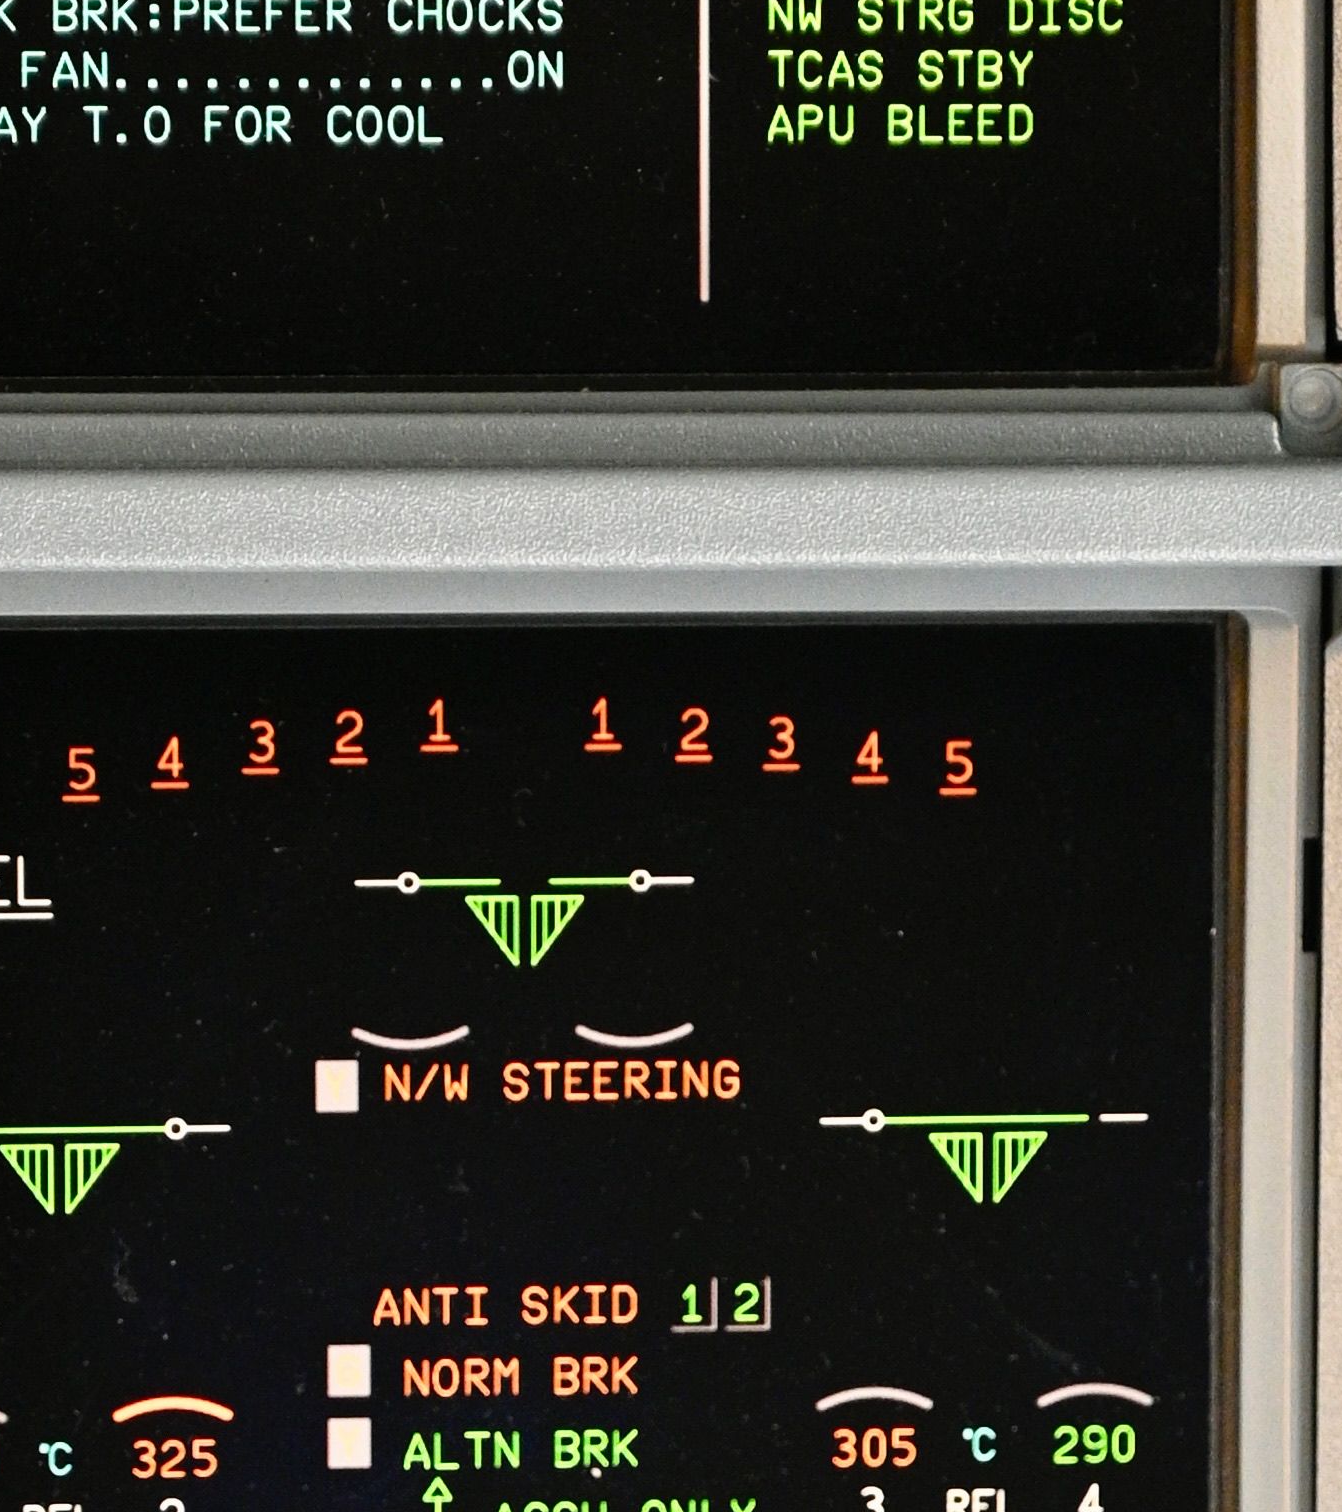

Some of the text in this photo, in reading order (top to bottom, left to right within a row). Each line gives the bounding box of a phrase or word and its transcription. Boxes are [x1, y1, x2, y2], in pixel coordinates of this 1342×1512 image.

[767, 49, 1034, 91] TCAS STBY
[82, 105, 171, 145] T.O
[204, 104, 292, 145] FOR
[326, 104, 444, 145] COOL
[767, 103, 1034, 145] APU BLEED
[384, 1063, 469, 1102] N/W
[502, 1059, 741, 1102] STEERING
[373, 1283, 638, 1327] ANTI SKID
[403, 1355, 639, 1398] NORM BRK
[131, 1438, 218, 1479] 325
[403, 1428, 639, 1471] ALTN BRK
[831, 1424, 1136, 1469] 305 290
